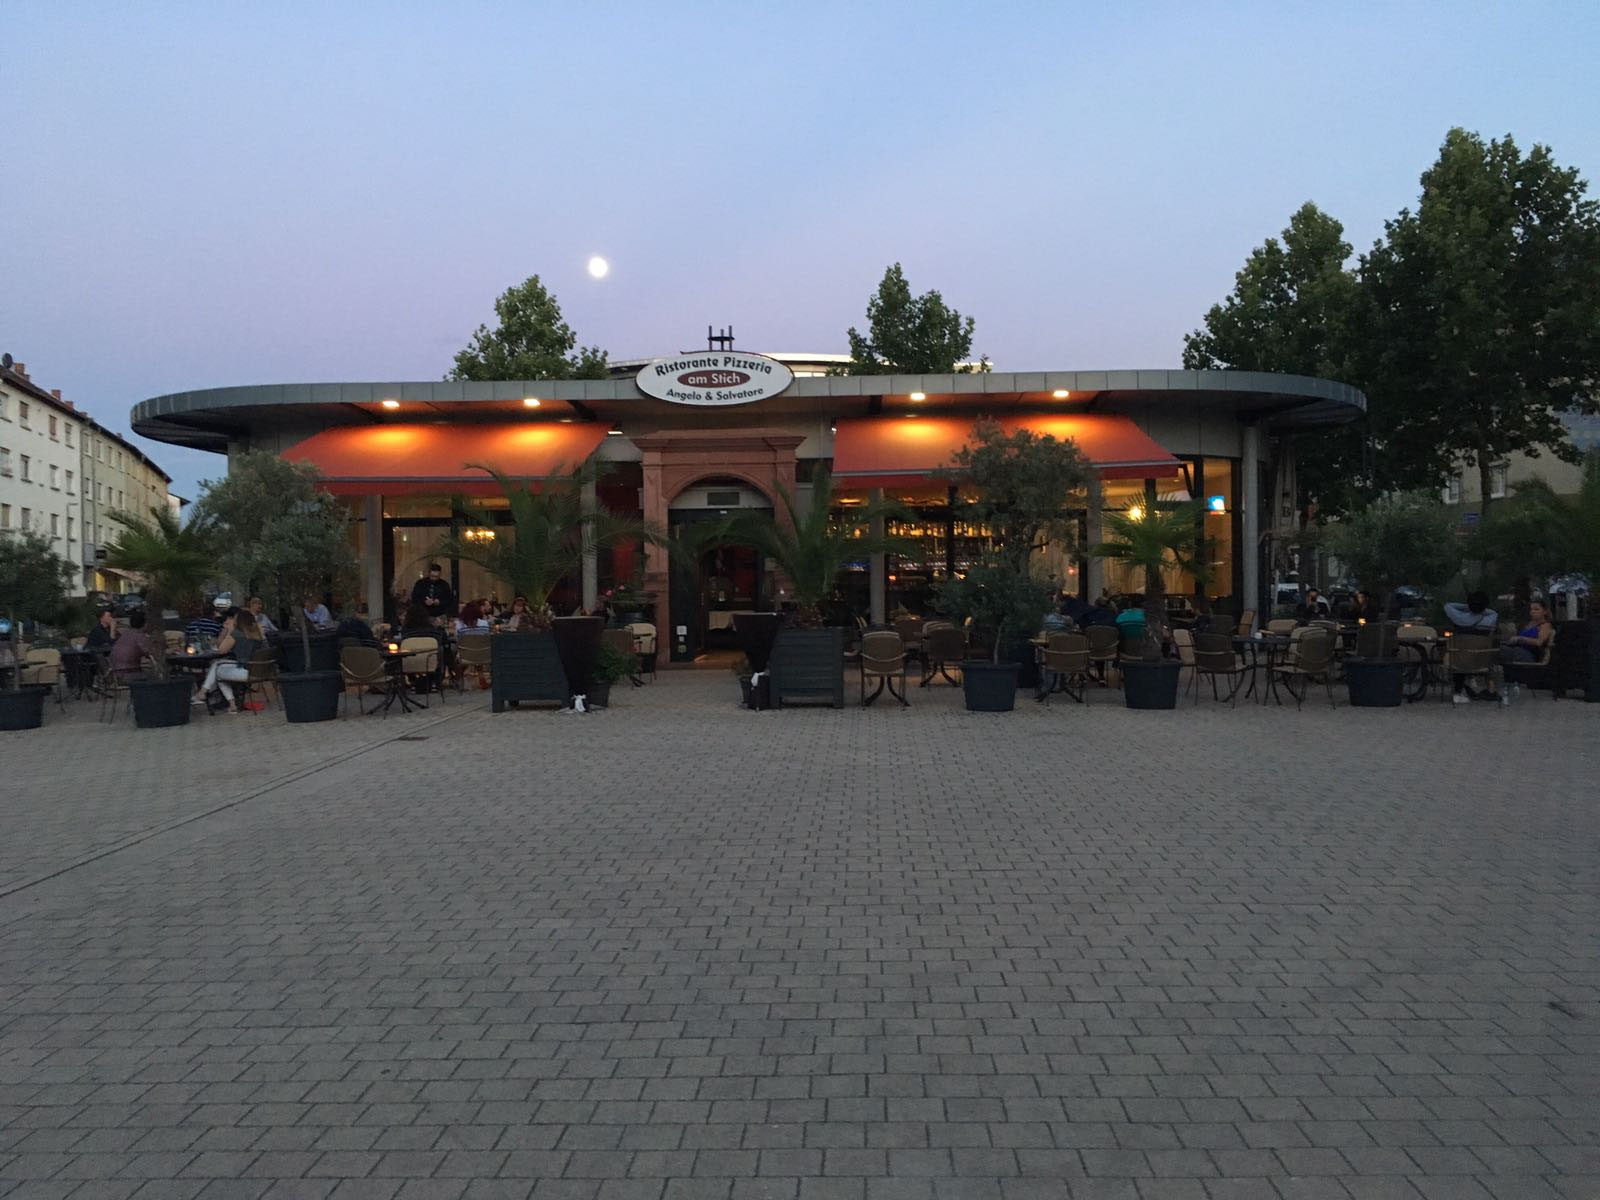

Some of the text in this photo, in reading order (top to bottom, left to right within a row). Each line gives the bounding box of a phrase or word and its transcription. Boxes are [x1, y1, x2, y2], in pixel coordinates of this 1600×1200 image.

[655, 356, 773, 377] Ristorante Pizzeria
[688, 373, 741, 385] am Stich
[666, 387, 764, 401] Angelo & Salvatore
